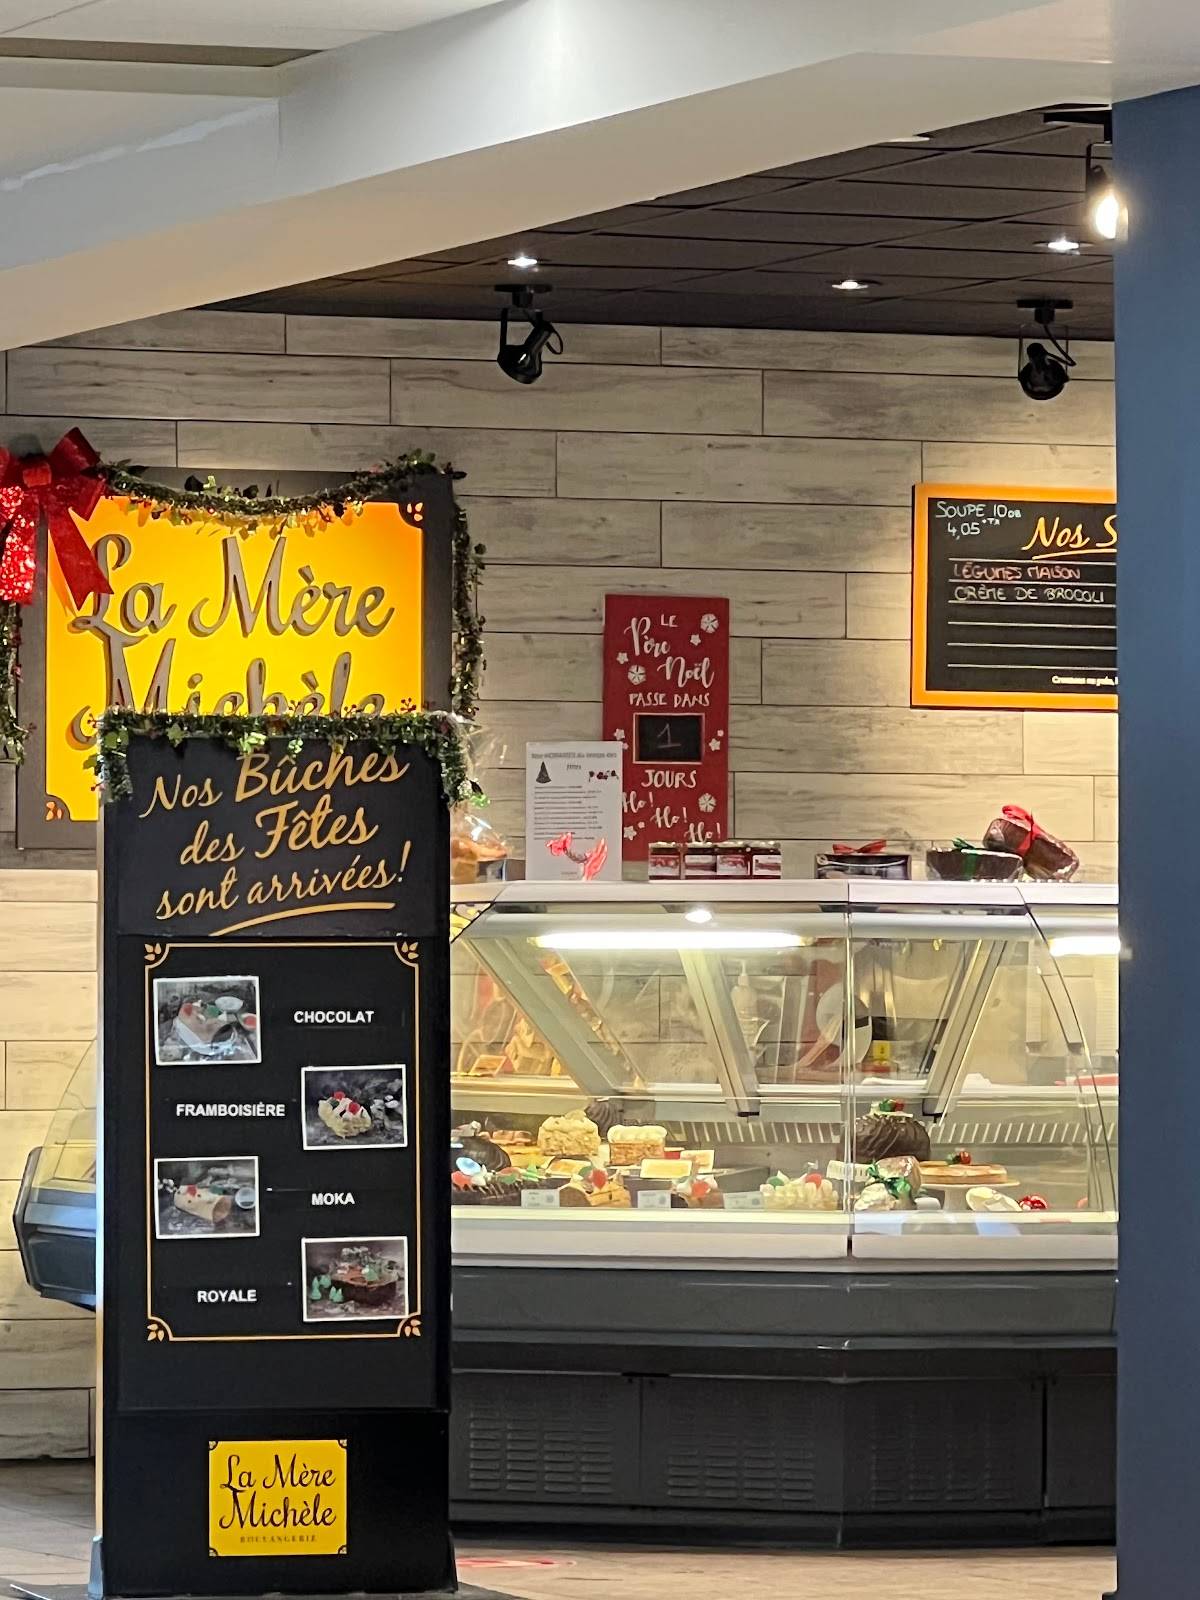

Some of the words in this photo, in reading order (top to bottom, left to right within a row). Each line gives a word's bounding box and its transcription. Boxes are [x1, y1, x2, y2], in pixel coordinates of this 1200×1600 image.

[935, 501, 986, 518] SOUPE
[947, 522, 980, 540] 4,05
[1022, 516, 1090, 551] Nos
[954, 562, 1022, 580] LÉGUMES
[1027, 566, 1081, 580] MAISON
[68, 534, 176, 647] La
[188, 533, 395, 637] Mère
[1015, 588, 1038, 600] DE
[1044, 587, 1104, 603] BROCOLI
[661, 614, 678, 628] LE
[624, 616, 671, 657] Père
[657, 656, 715, 688] Noël
[629, 692, 668, 706] PASSE
[673, 693, 710, 707] DANS
[657, 723, 682, 748] 1
[138, 774, 223, 818] Nos
[235, 750, 410, 803] Bûches
[641, 770, 697, 788] JOURS
[180, 820, 244, 865] des
[254, 794, 379, 859] Fêtes
[156, 867, 239, 920] sont
[293, 1010, 375, 1024] CHOCOLAT
[175, 1102, 286, 1118] FRAMBOISIÈRE
[311, 1192, 355, 1206] MOKA
[197, 1289, 258, 1303] ROYALE
[219, 1454, 256, 1493] La
[262, 1453, 336, 1488] Mère
[218, 1491, 337, 1529] Michèle
